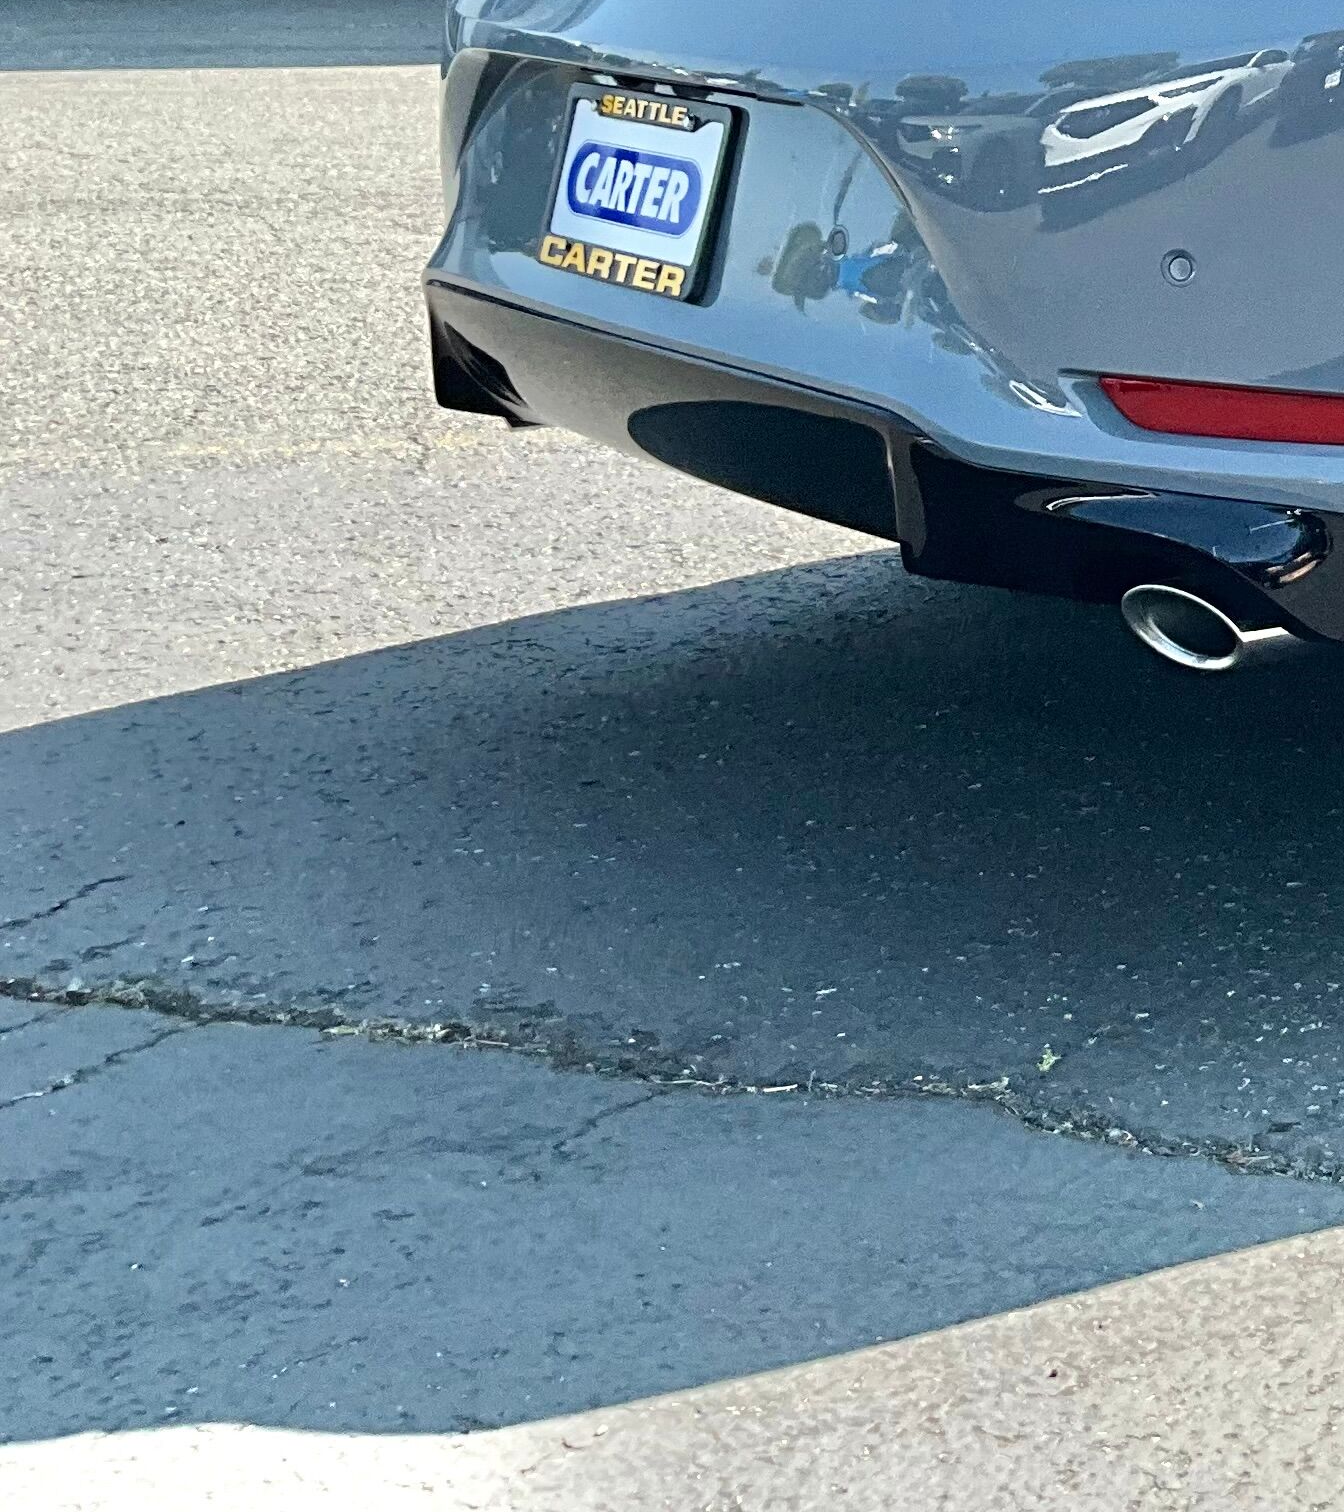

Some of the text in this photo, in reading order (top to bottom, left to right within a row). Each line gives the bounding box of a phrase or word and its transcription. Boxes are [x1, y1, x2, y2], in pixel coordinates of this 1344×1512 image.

[600, 94, 689, 125] SEATTLE
[575, 151, 690, 224] CARTER
[539, 234, 687, 297] CARTER
